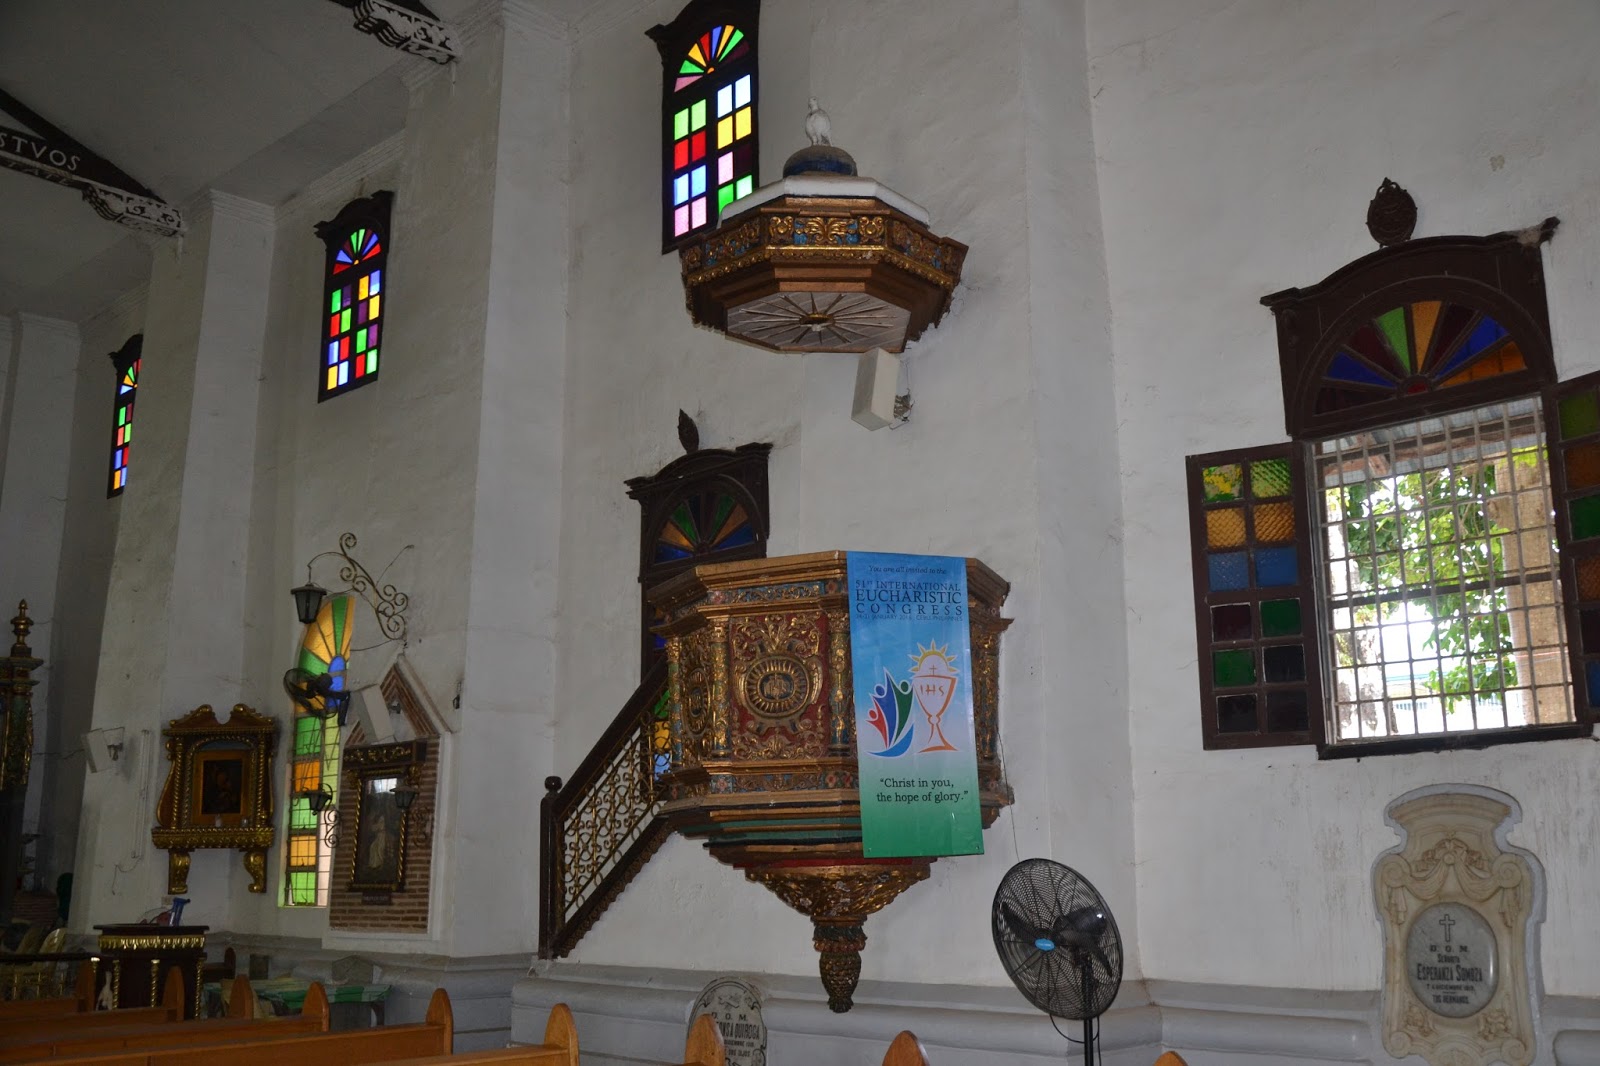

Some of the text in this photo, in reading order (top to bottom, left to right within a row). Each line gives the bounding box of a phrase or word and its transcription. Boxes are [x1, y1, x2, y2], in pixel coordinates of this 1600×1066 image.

[869, 565, 881, 573] You
[937, 567, 947, 575] the
[876, 580, 960, 591] INTERNATIONAL
[856, 589, 962, 604] EUCHARISTIC
[856, 602, 963, 615] CONGRESS
[920, 683, 945, 697] IHS
[918, 778, 928, 788] in
[931, 779, 954, 790] you,
[876, 792, 892, 802] the
[895, 792, 919, 804] hope
[921, 791, 932, 802] of
